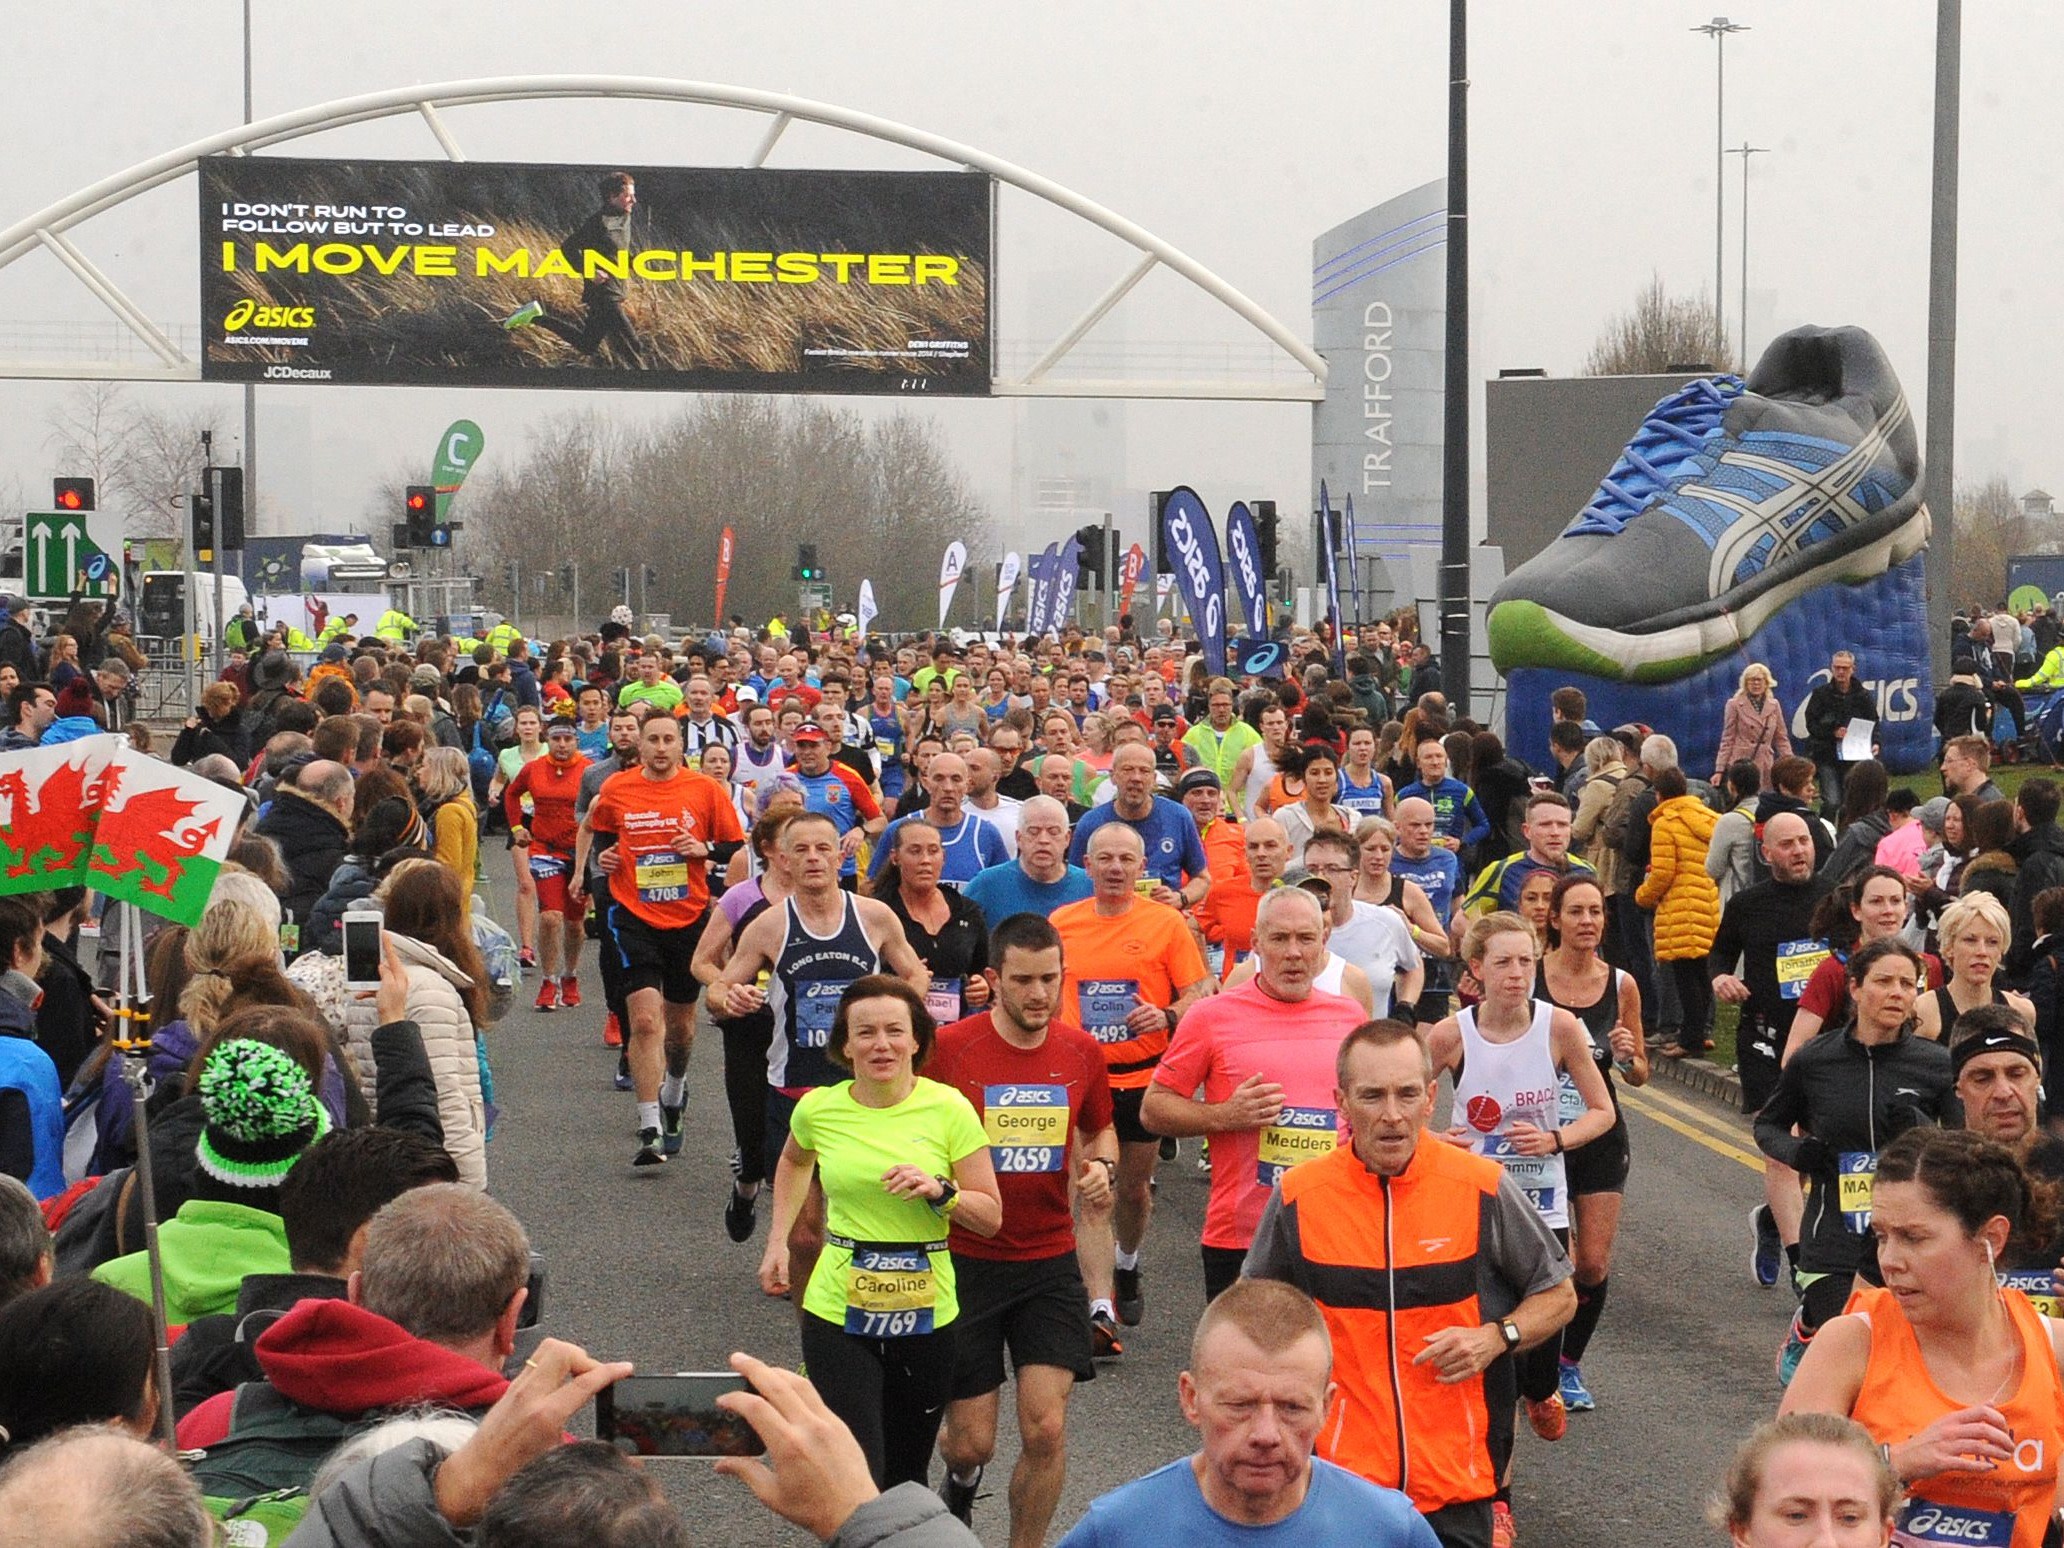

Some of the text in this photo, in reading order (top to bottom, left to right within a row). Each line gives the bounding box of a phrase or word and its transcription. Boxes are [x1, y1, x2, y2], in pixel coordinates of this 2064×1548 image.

[222, 203, 406, 219] I DON'T RUN TO
[222, 219, 495, 238] FOLLOW BUT TO LEAD
[222, 241, 958, 285] I MOVE MANCHESTER
[263, 366, 332, 379] JCDecaux
[1364, 301, 1392, 494] TRAFFORD
[448, 433, 469, 465] C
[946, 551, 959, 572] A
[649, 868, 675, 878] John
[648, 887, 679, 901] 4708
[786, 954, 814, 975] LONG
[815, 951, 851, 961] EATON
[1091, 1001, 1125, 1012] Colin
[997, 1113, 1057, 1131] George
[1266, 1132, 1332, 1151] Medders
[1000, 1146, 1052, 1171] 2659
[1505, 1160, 1545, 1176] ammy
[855, 1275, 927, 1294] Caroline
[862, 1310, 917, 1336] 7769
